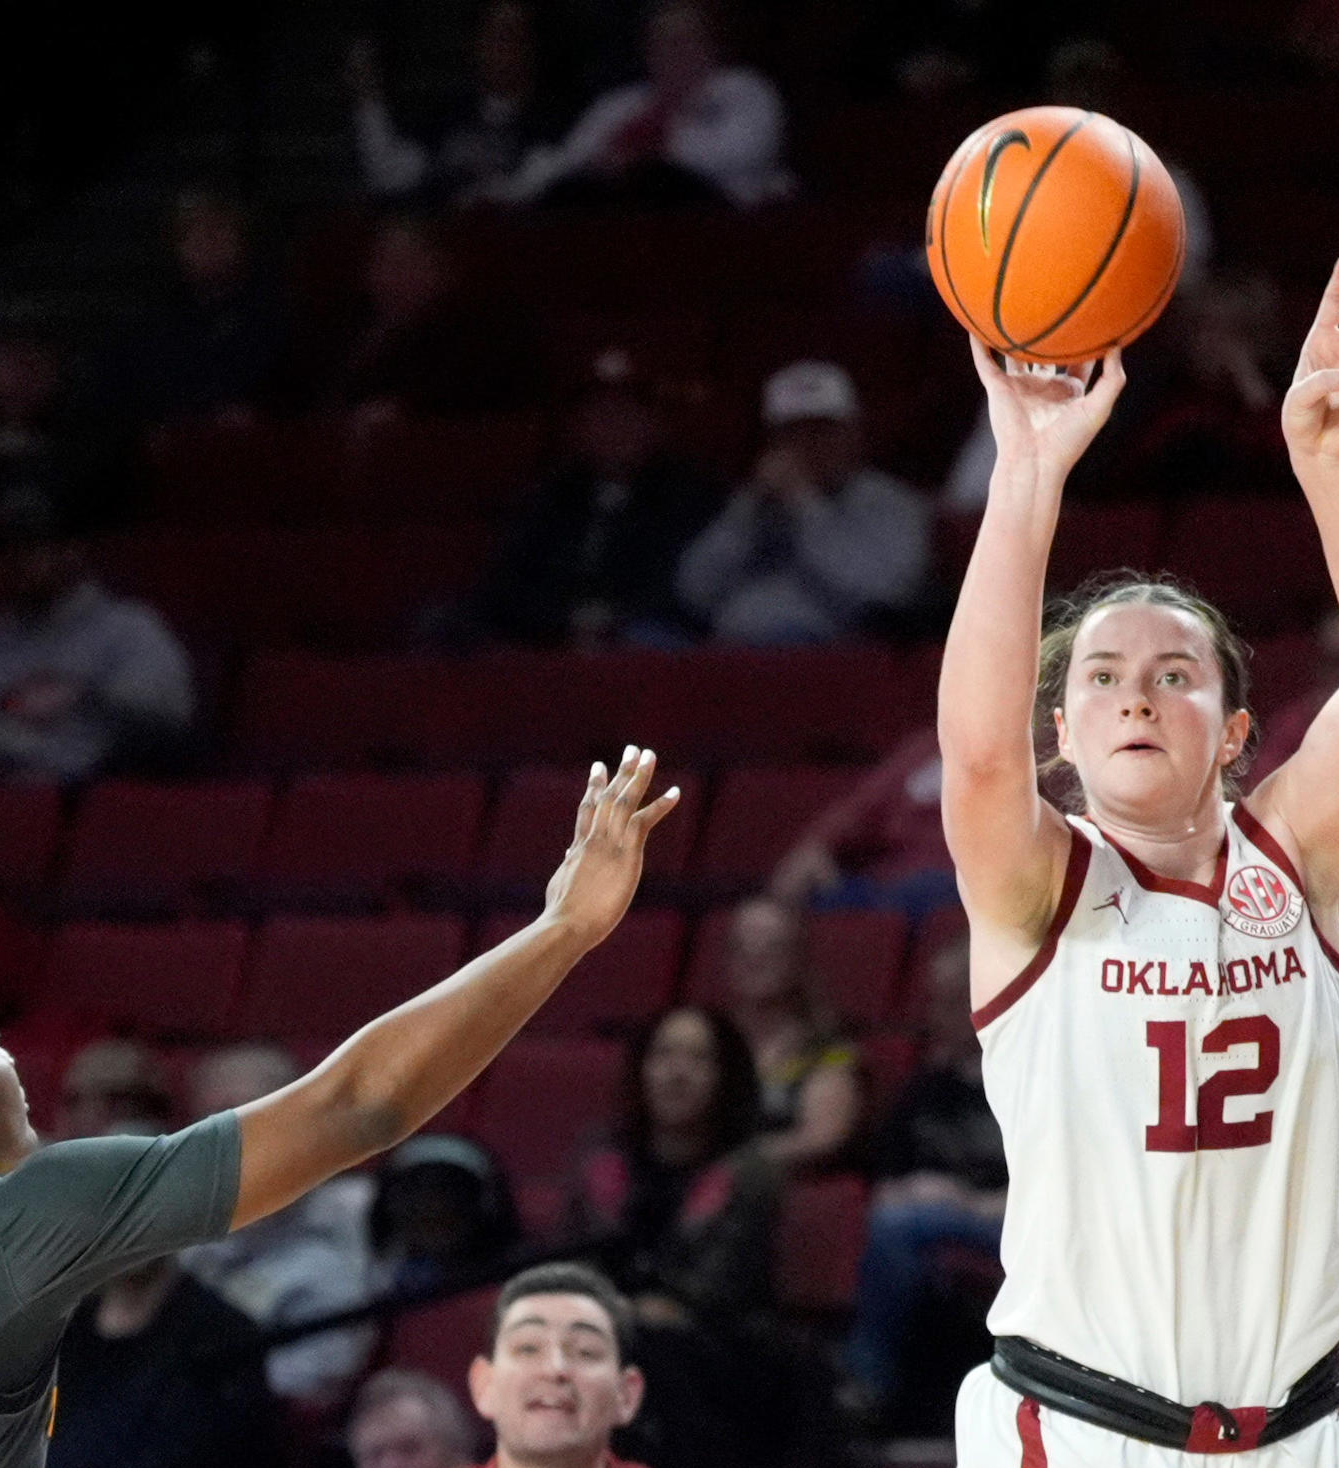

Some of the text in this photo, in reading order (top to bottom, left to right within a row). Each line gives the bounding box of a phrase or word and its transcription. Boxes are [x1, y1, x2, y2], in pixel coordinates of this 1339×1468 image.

[1229, 866, 1286, 919] SEC
[1241, 908, 1299, 936] GRADUATE
[1101, 946, 1306, 996] OKLAHOMA
[1145, 1014, 1280, 1152] 12
